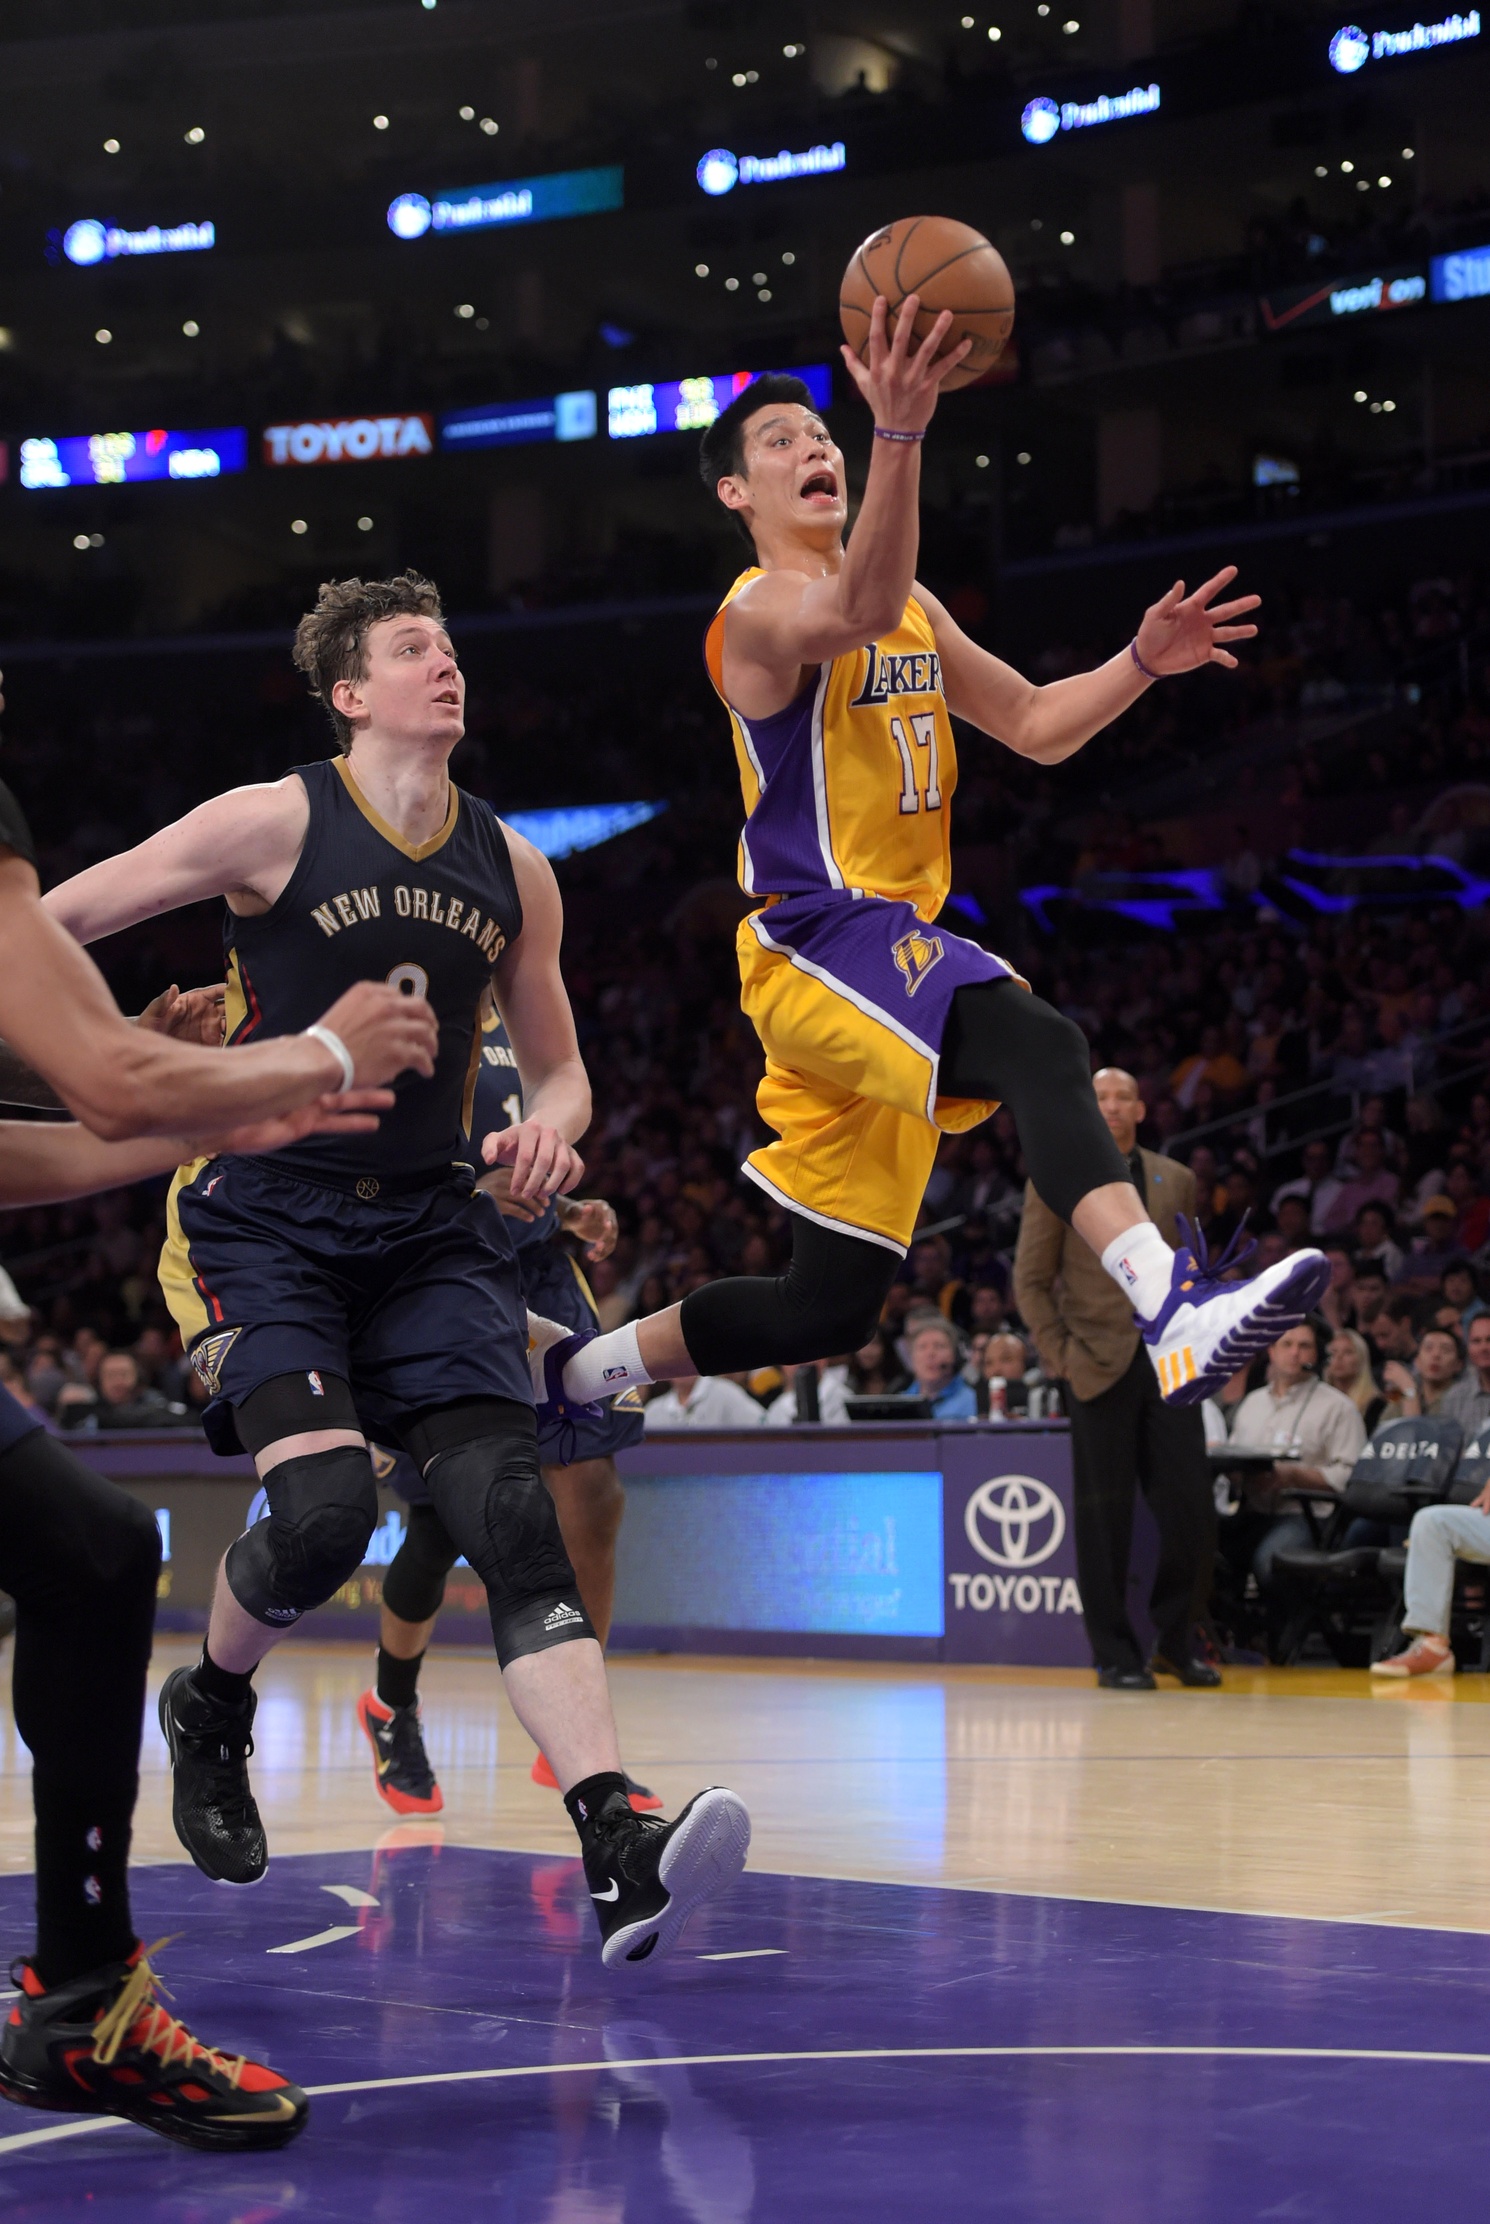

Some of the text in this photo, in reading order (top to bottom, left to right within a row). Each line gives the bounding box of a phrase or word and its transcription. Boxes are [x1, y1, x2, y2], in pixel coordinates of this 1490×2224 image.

[263, 416, 433, 465] TOYOTA
[889, 711, 942, 815] 17
[310, 885, 507, 964] NEW ORLEANS
[1379, 1440, 1439, 1460] DELTA
[949, 1573, 1084, 1615] TOYOTA
[543, 1610, 581, 1625] adidas
